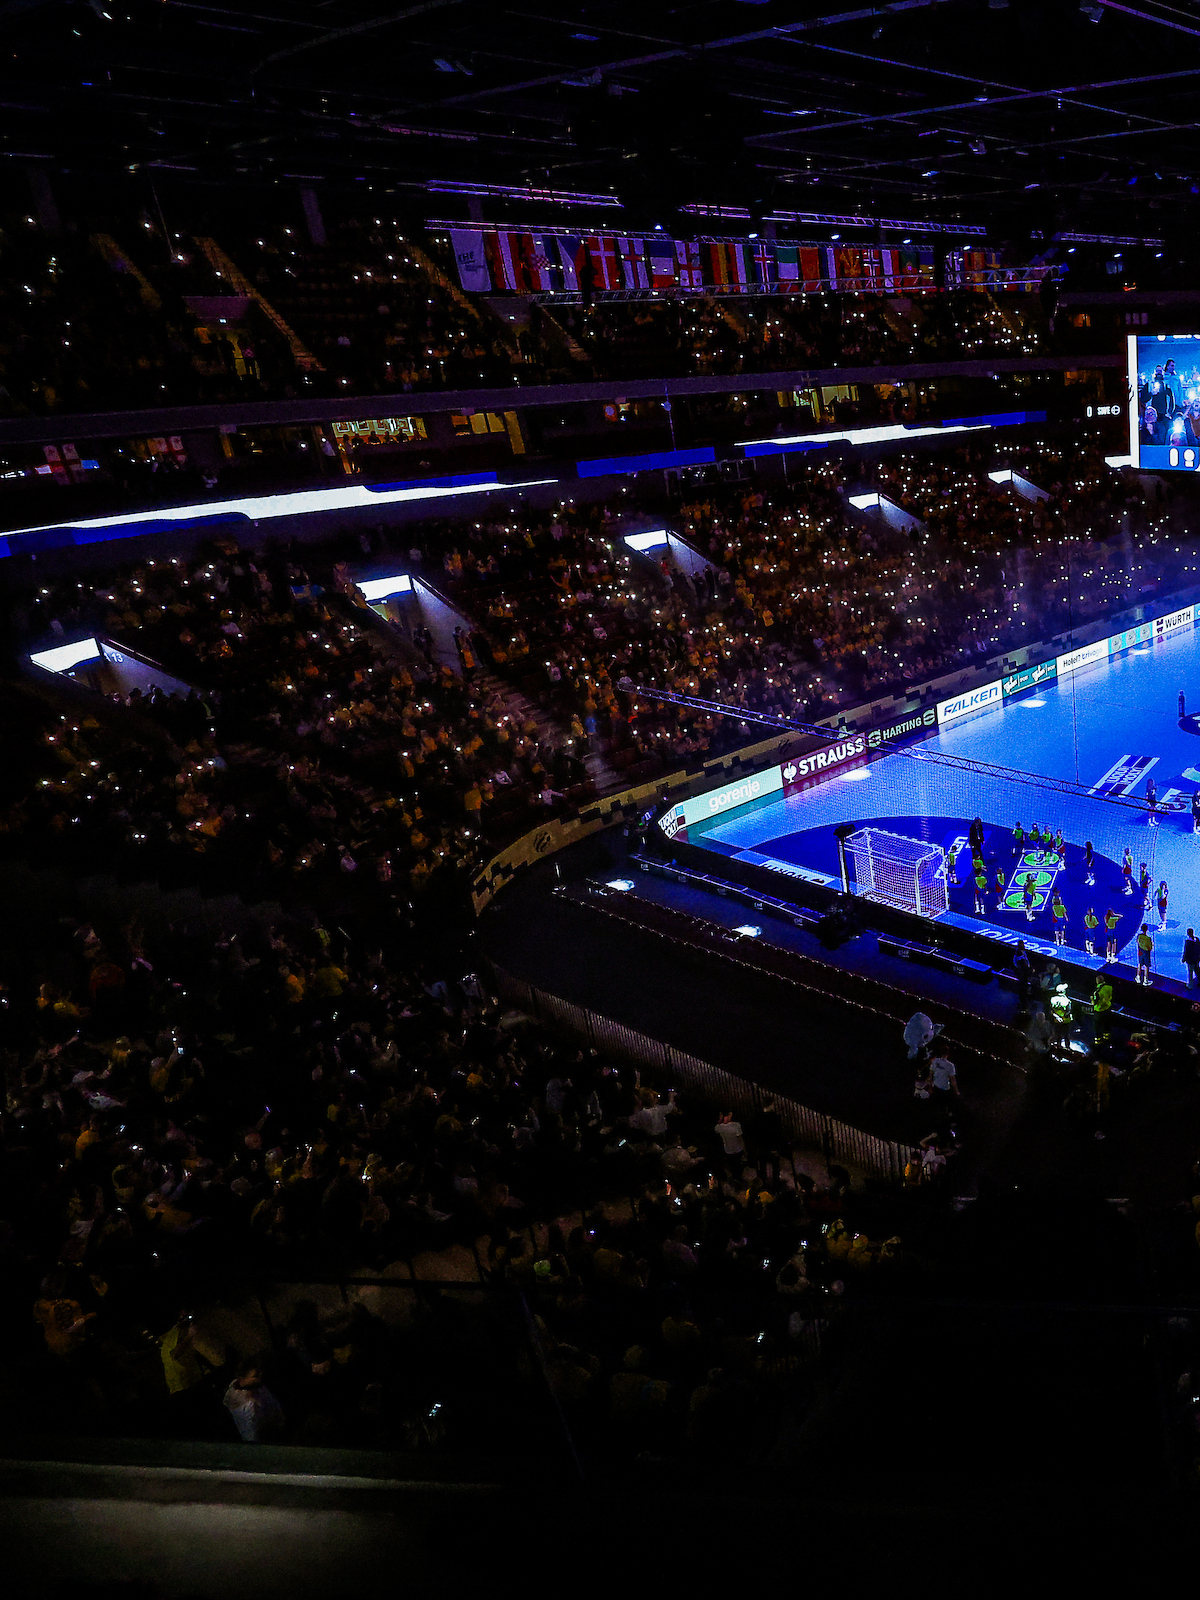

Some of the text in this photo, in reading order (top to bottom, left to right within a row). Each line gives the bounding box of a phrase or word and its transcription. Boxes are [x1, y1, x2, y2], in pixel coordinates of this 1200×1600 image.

[1165, 611, 1191, 629] WÜRTH
[943, 686, 998, 717] FALKEN
[883, 716, 922, 741] HARTING
[798, 737, 864, 776] STRAUSS
[709, 780, 760, 812] gorenje
